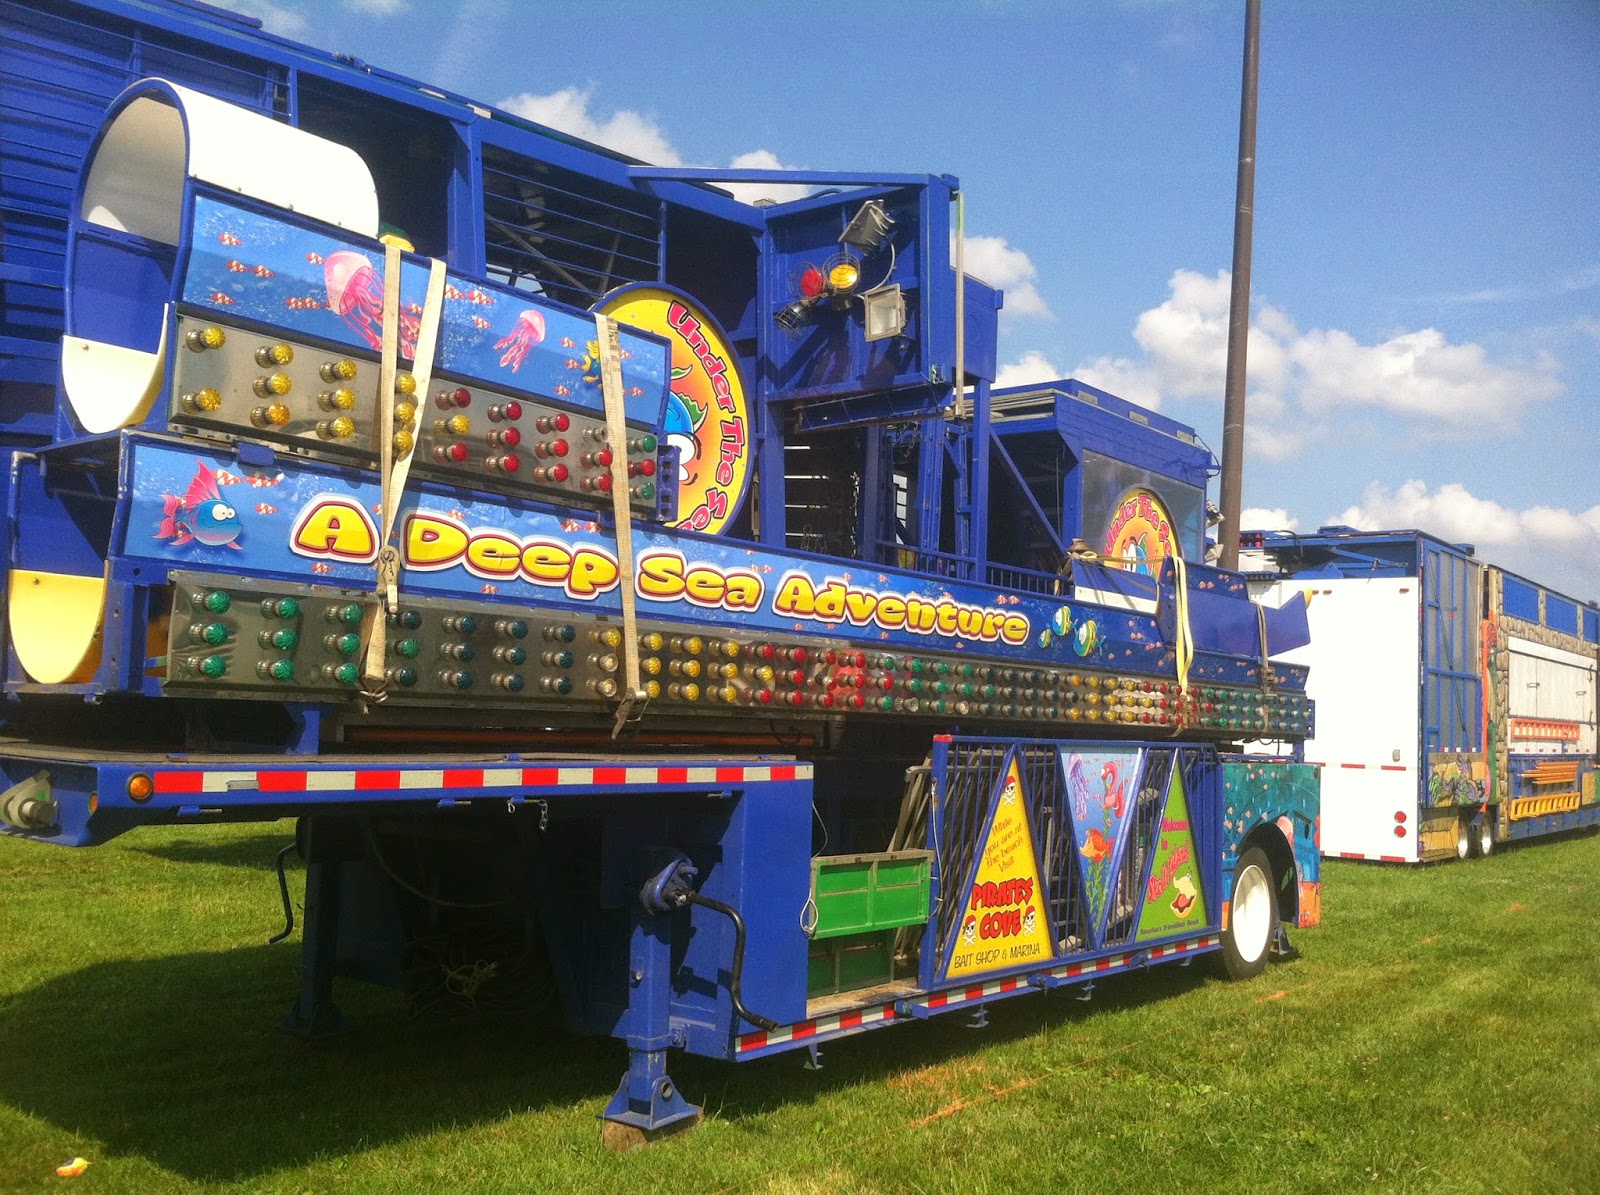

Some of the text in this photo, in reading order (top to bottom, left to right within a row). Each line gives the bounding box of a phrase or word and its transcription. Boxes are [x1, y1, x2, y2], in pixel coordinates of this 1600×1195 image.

[667, 300, 736, 414] Under
[718, 417, 745, 487] The
[1137, 492, 1159, 530] The
[288, 494, 1031, 645] A Deep Sea Adventure
[985, 822, 1023, 859] you are at
[991, 817, 1012, 836] While
[986, 835, 1024, 868] the beach
[971, 877, 1034, 911] PIRATES
[979, 908, 1022, 941] COVE
[954, 953, 974, 969] BAIT
[975, 948, 1000, 965] SHOP
[1009, 943, 1040, 959] MARINA
